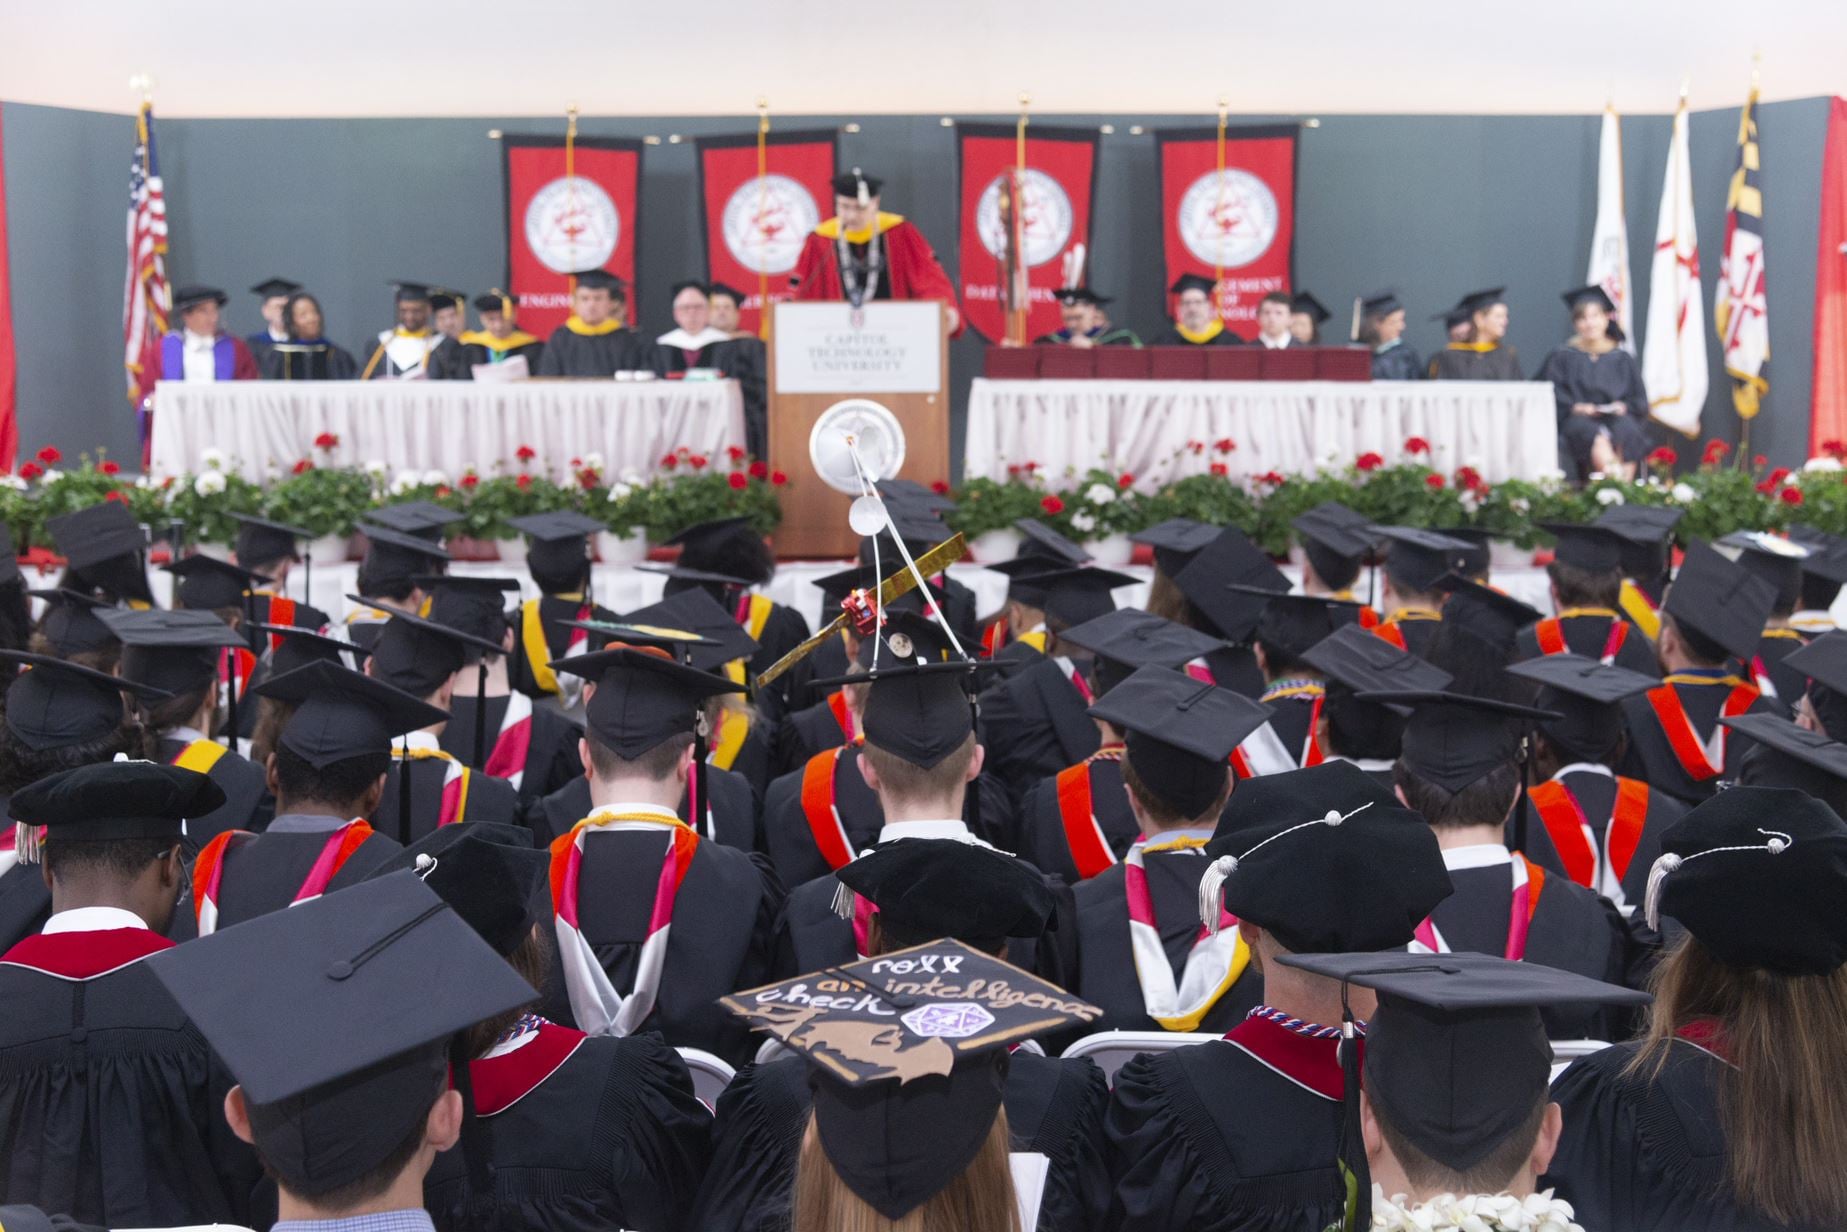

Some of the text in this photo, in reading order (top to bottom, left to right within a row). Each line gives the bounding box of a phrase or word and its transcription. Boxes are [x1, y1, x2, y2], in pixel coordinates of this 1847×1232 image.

[823, 334, 887, 344] CAPITOL
[807, 347, 907, 358] TECHNOLOGY
[811, 360, 902, 371] UNIVERSITY
[755, 983, 896, 1016] check
[816, 979, 866, 992] an
[884, 976, 1104, 1022] intelligence
